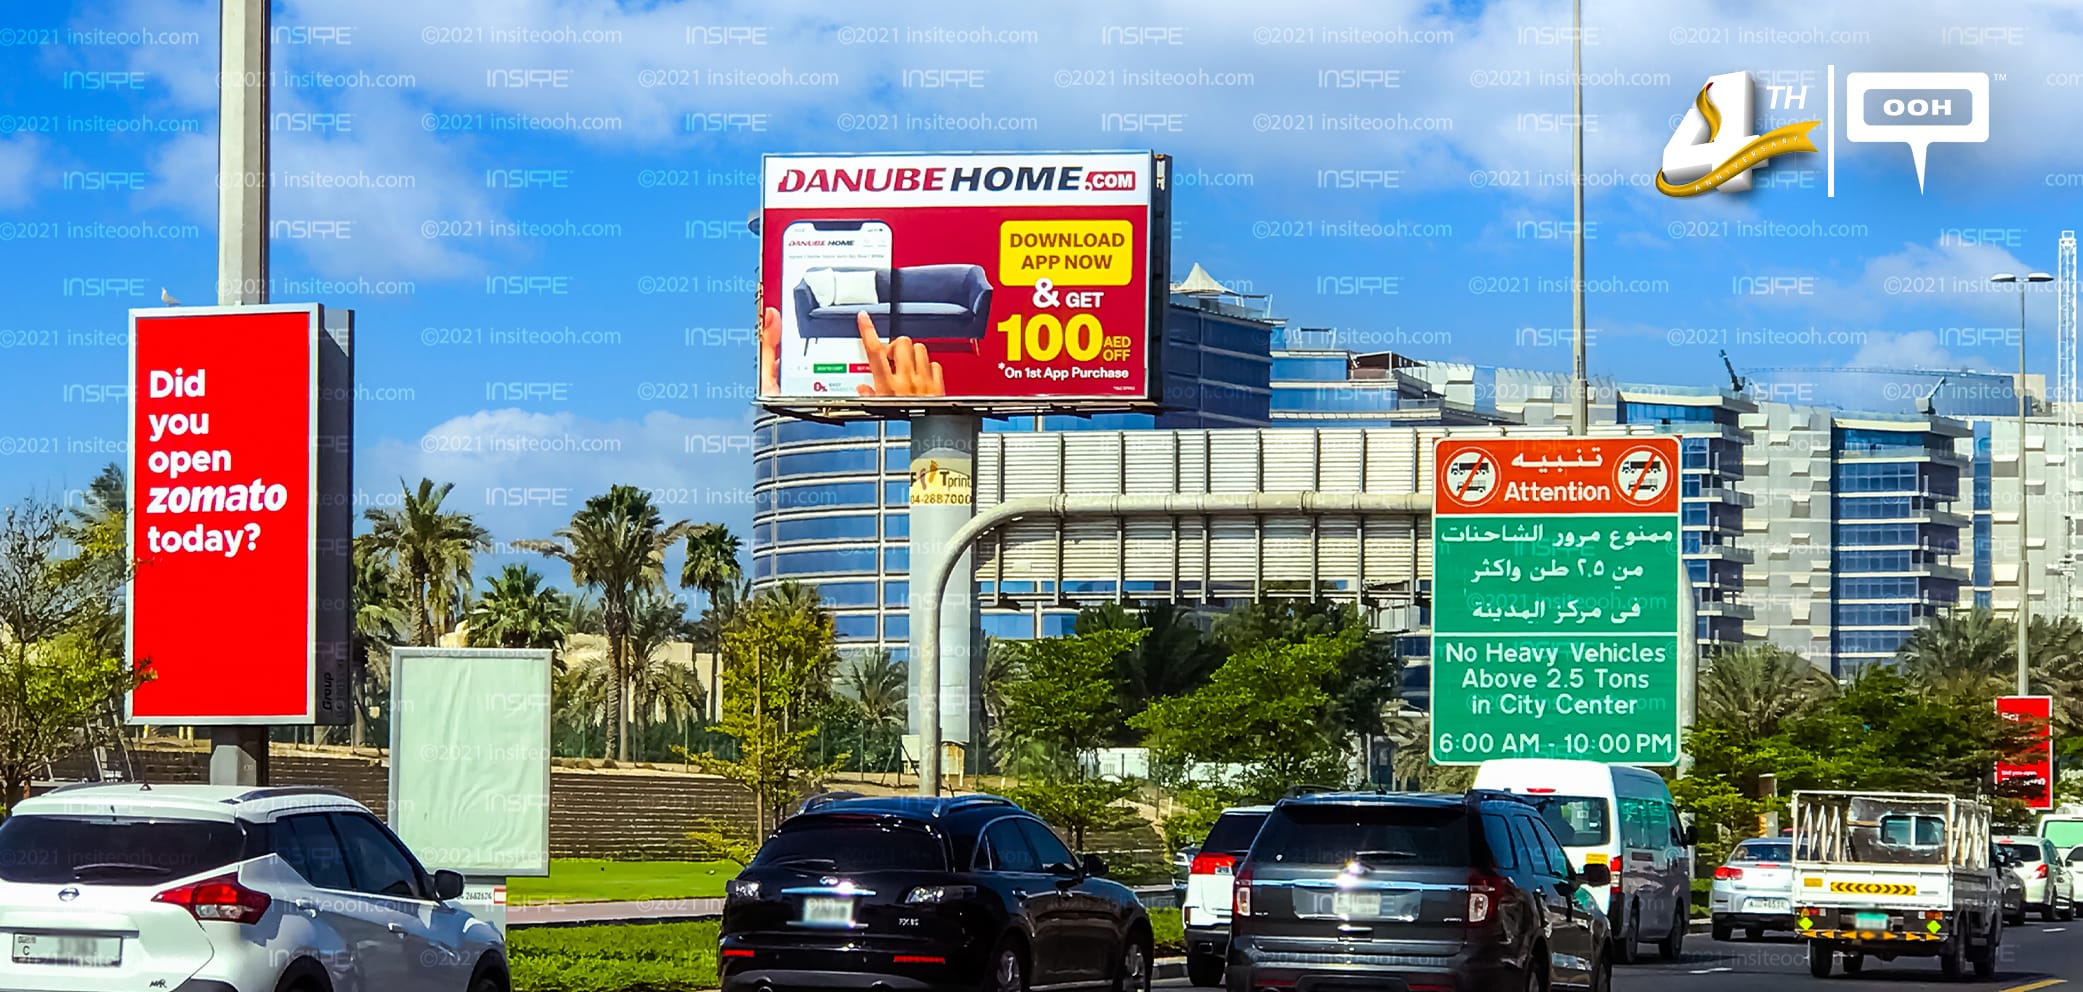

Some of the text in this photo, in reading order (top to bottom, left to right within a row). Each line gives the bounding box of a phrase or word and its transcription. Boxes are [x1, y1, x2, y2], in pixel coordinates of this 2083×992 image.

[1010, 233, 1125, 248] DOWNLOAD
[1021, 254, 1113, 270] APP NOW
[1032, 277, 1104, 308] & GET
[997, 313, 1104, 362] 100
[1103, 336, 1132, 348] AED
[1103, 349, 1131, 362] OFF
[149, 367, 206, 398] Did
[1025, 367, 1042, 379] 1st
[1043, 367, 1069, 381] App
[1071, 366, 1129, 379] Purchase
[148, 412, 209, 442] you
[148, 449, 231, 479] open
[1511, 447, 1603, 473] تنبيه
[146, 478, 288, 513] zomato
[1504, 481, 1611, 501] Attention
[147, 522, 261, 558] today?
[1441, 523, 1673, 550] ممنوع مرور الشاحنات
[1529, 558, 1570, 581] طن
[1612, 563, 1644, 582] من
[1472, 600, 1546, 624] المدينة
[1553, 600, 1602, 624] مركز
[1445, 642, 1666, 667] No Heavy Vehicles
[1462, 668, 1650, 689] Above 2.5 Tons
[322, 672, 334, 711] Group
[1471, 693, 1638, 719] in City Center
[1439, 733, 1494, 753] 6:00
[1501, 733, 1540, 753] AM
[1563, 733, 1631, 753] 10:00
[1636, 733, 1672, 753] PM
